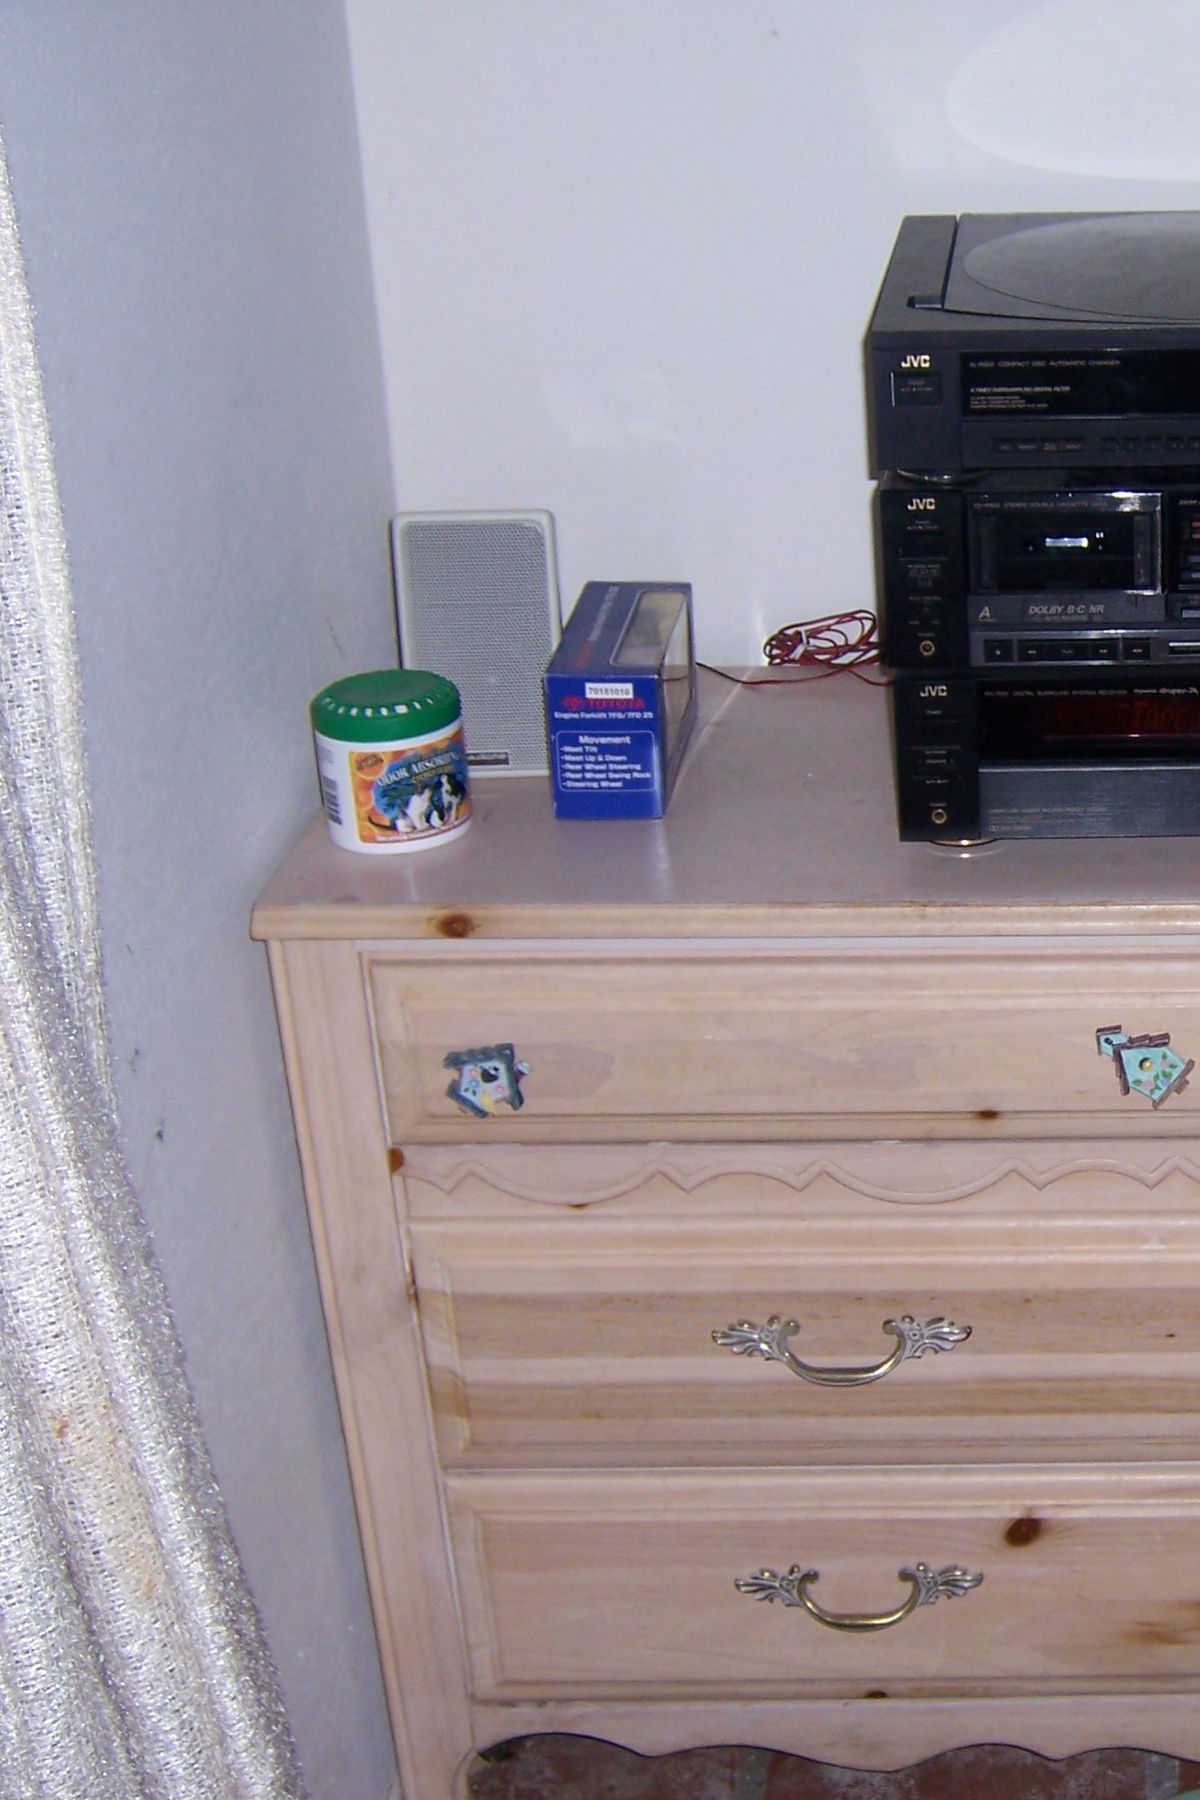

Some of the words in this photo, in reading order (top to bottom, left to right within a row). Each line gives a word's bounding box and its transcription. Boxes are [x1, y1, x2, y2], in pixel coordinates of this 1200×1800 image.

[901, 355, 930, 368] JVC
[907, 498, 935, 511] JVC
[979, 606, 991, 618] A
[1029, 604, 1064, 614] DOLBY
[1088, 604, 1104, 613] NR
[920, 685, 947, 697] JVC
[588, 697, 645, 709] TOYOTA
[579, 735, 631, 744] Movement
[608, 763, 641, 771] Steering
[566, 780, 599, 788] Steering
[600, 780, 623, 788] Wheel
